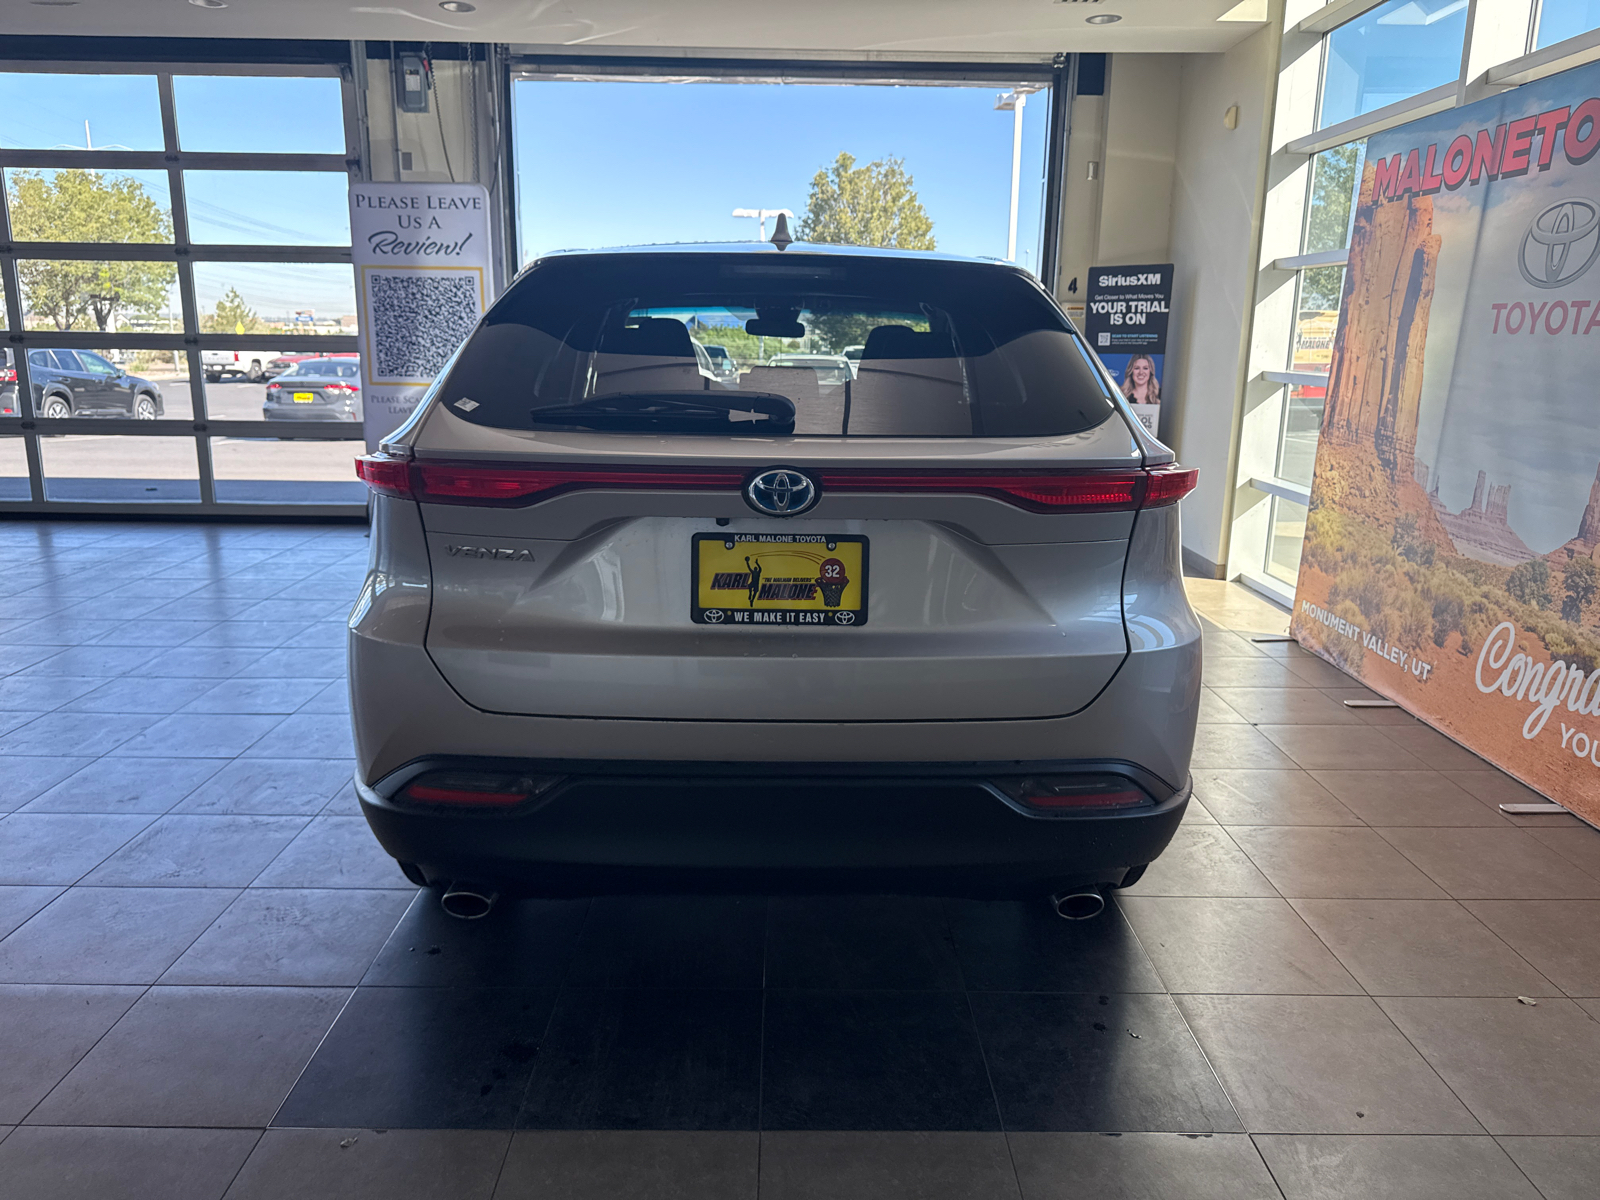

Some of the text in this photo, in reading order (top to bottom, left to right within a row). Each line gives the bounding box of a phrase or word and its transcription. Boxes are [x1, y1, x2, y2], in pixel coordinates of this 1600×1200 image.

[355, 193, 482, 210] PLEASE LEAVE
[398, 214, 442, 230] US A
[367, 230, 473, 255] Review!
[1068, 277, 1078, 294] 4
[1098, 273, 1162, 287] SiriusXM
[1090, 302, 1126, 314] YOUR
[1129, 301, 1169, 313] TRIAL
[1110, 313, 1146, 325] IS ON
[370, 394, 401, 404] PLEASE
[445, 544, 535, 562] VENZA
[825, 565, 840, 578] 32
[710, 572, 751, 590] KARL
[757, 583, 817, 600] MALONE
[734, 612, 826, 623] WE MAKE IT EASY
[1301, 600, 1432, 680] MONUMENT VALLEY, UT
